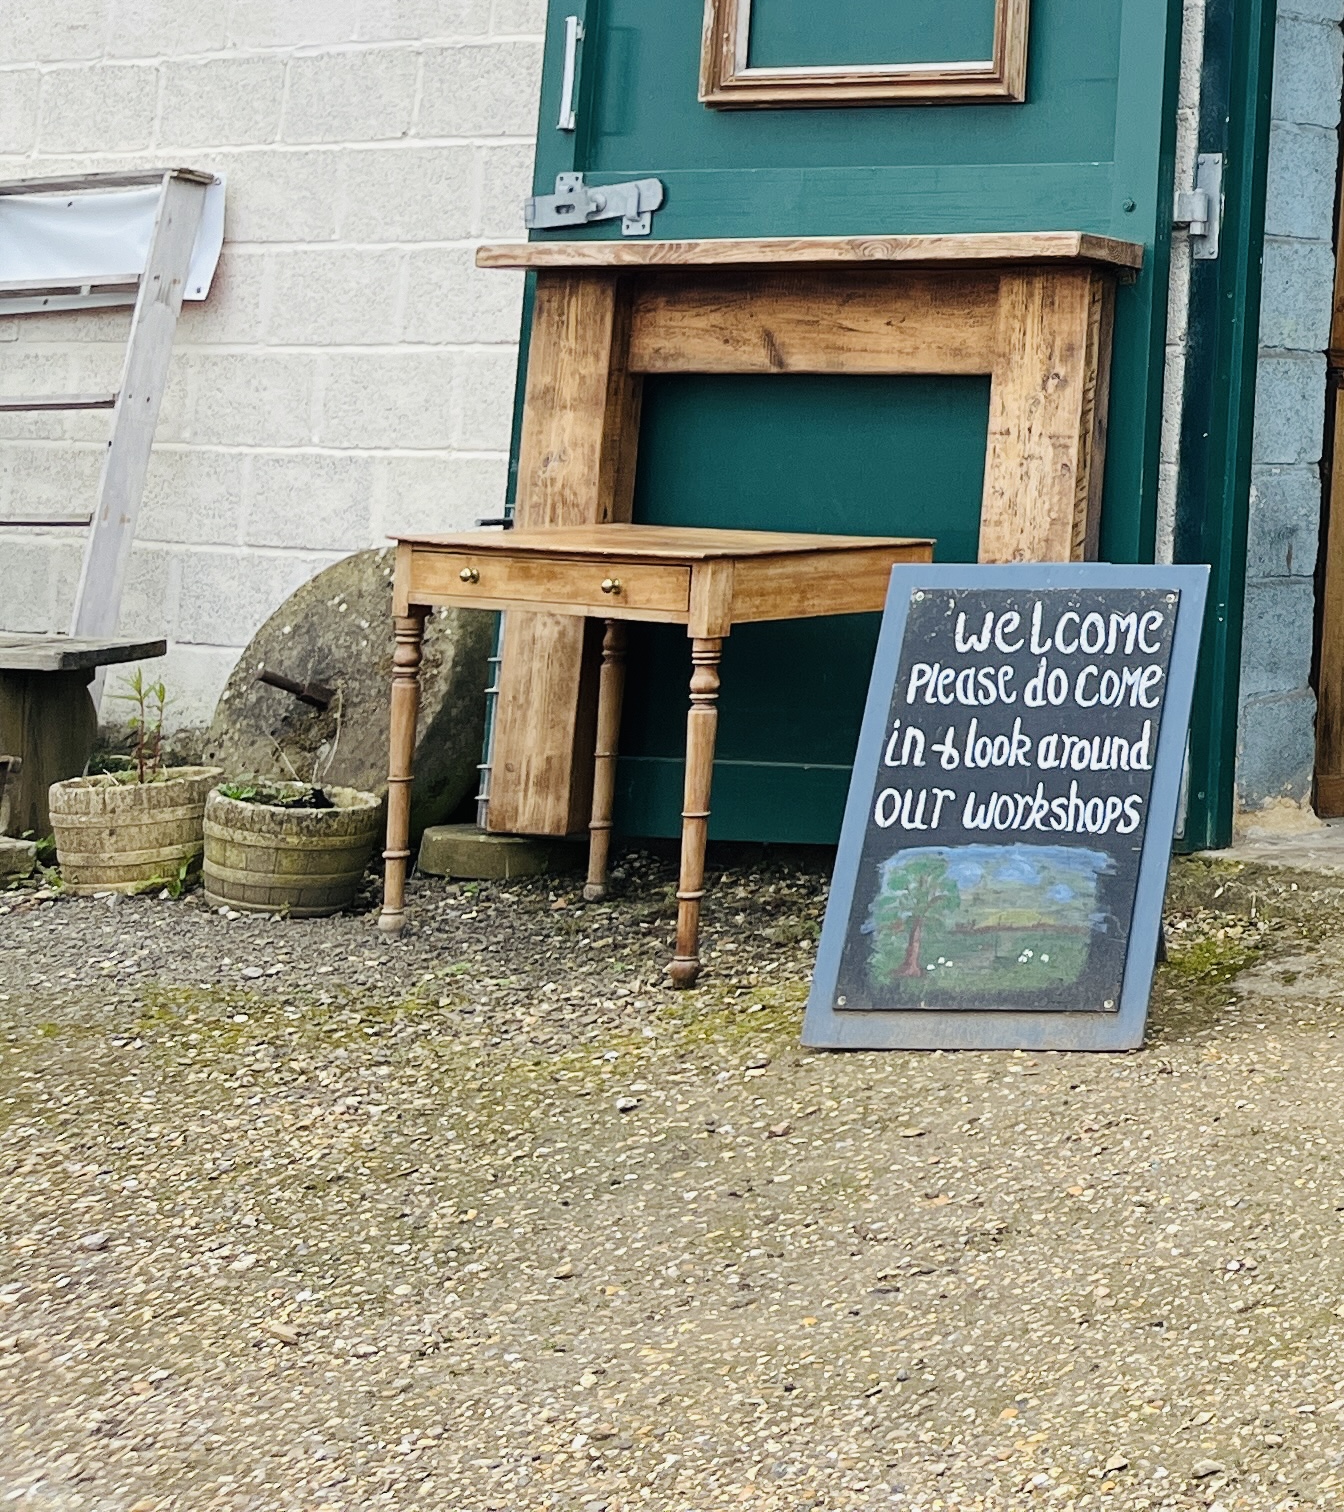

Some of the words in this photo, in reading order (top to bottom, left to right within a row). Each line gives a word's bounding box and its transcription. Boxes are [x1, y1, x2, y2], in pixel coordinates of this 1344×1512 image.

[906, 662, 1017, 706] Please
[1024, 657, 1068, 708] do
[884, 718, 926, 767] in
[965, 717, 1032, 768] look
[1038, 720, 1153, 771] around
[963, 781, 1143, 835] workshops
